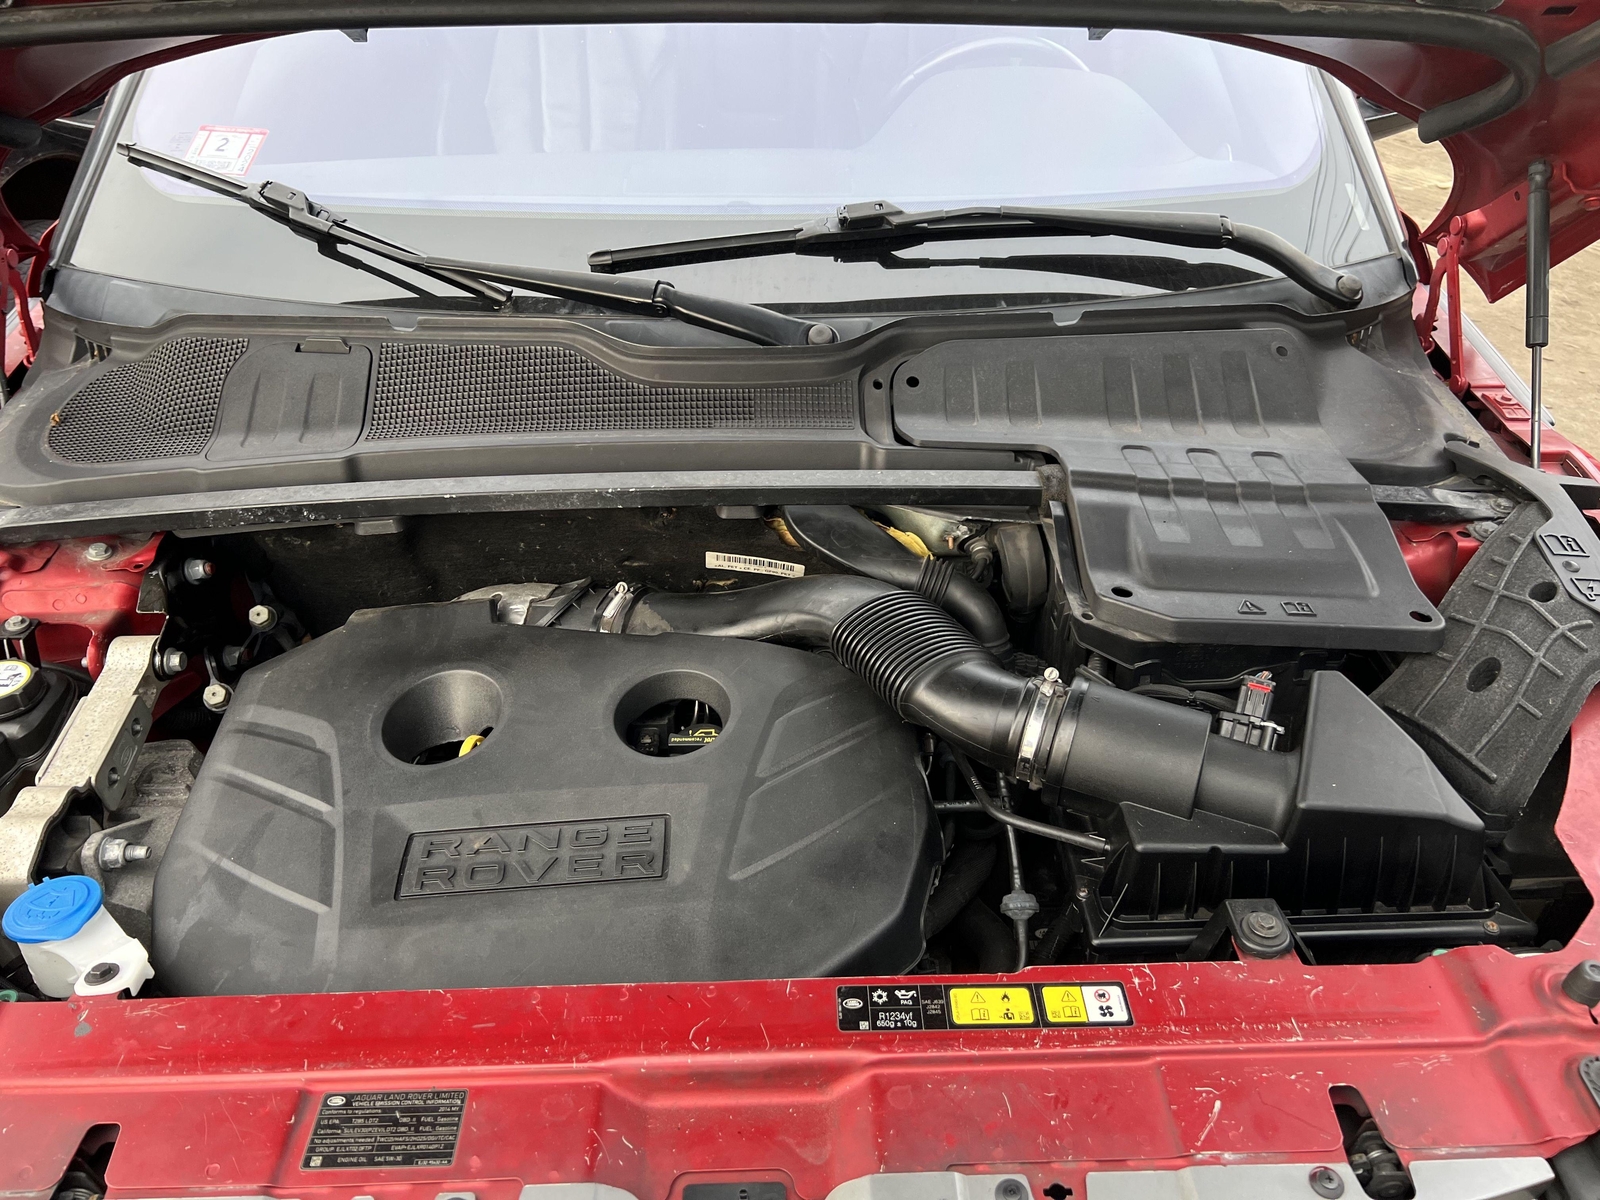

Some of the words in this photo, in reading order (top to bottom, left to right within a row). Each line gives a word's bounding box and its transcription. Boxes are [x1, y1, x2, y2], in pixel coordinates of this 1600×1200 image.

[215, 137, 230, 152] 2
[420, 820, 654, 861] RANGE
[414, 850, 656, 891] ROVER
[878, 1012, 913, 1021] R1234yf
[876, 1020, 895, 1028] 650g
[903, 1020, 917, 1028] 10g
[407, 1092, 433, 1100] ROVER
